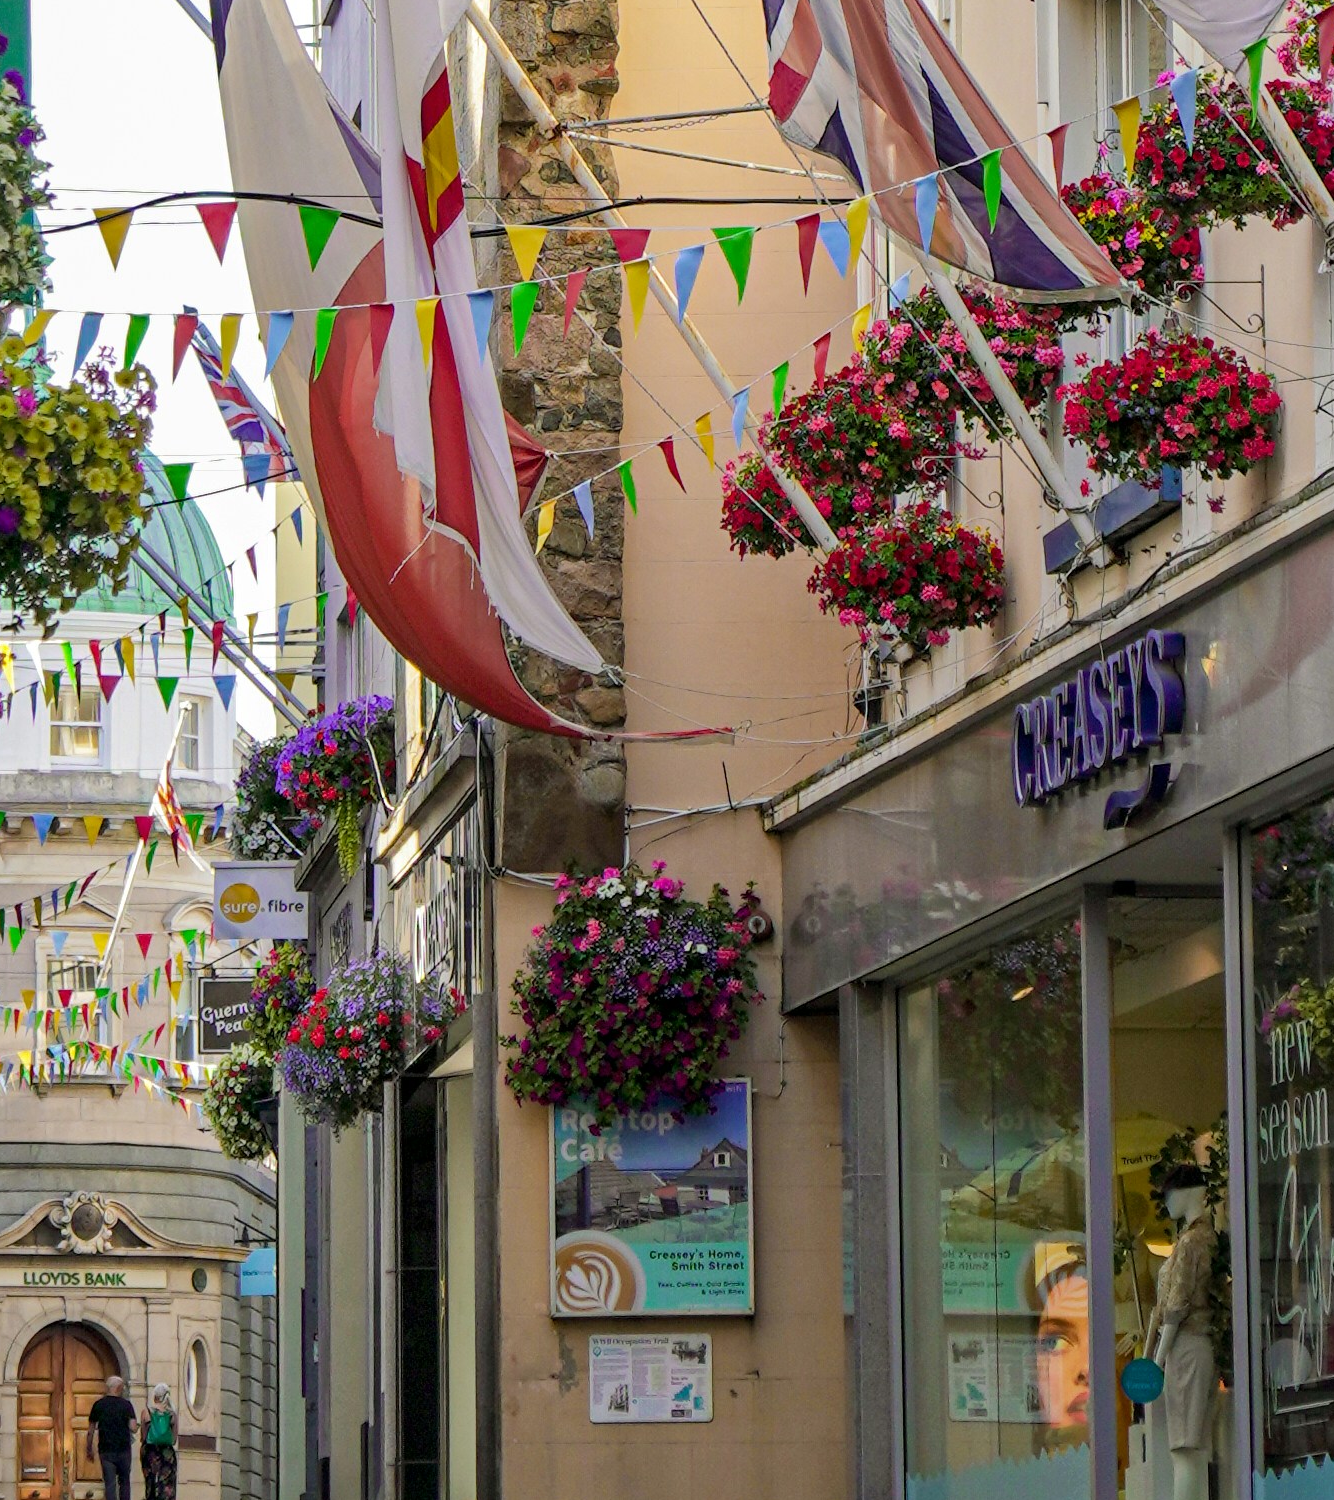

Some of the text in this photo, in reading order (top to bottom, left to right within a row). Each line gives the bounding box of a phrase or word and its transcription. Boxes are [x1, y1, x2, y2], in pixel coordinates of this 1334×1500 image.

[1012, 628, 1186, 808] CREASEYS
[201, 1002, 249, 1023] Guern
[215, 1018, 244, 1036] Pea
[1270, 1017, 1314, 1086] new
[1259, 1087, 1330, 1165] season
[560, 1134, 623, 1162] Café
[649, 1248, 745, 1261] Creasey's Home,
[671, 1261, 745, 1271] Smith Street
[23, 1271, 127, 1287] LLOYDS BANK
